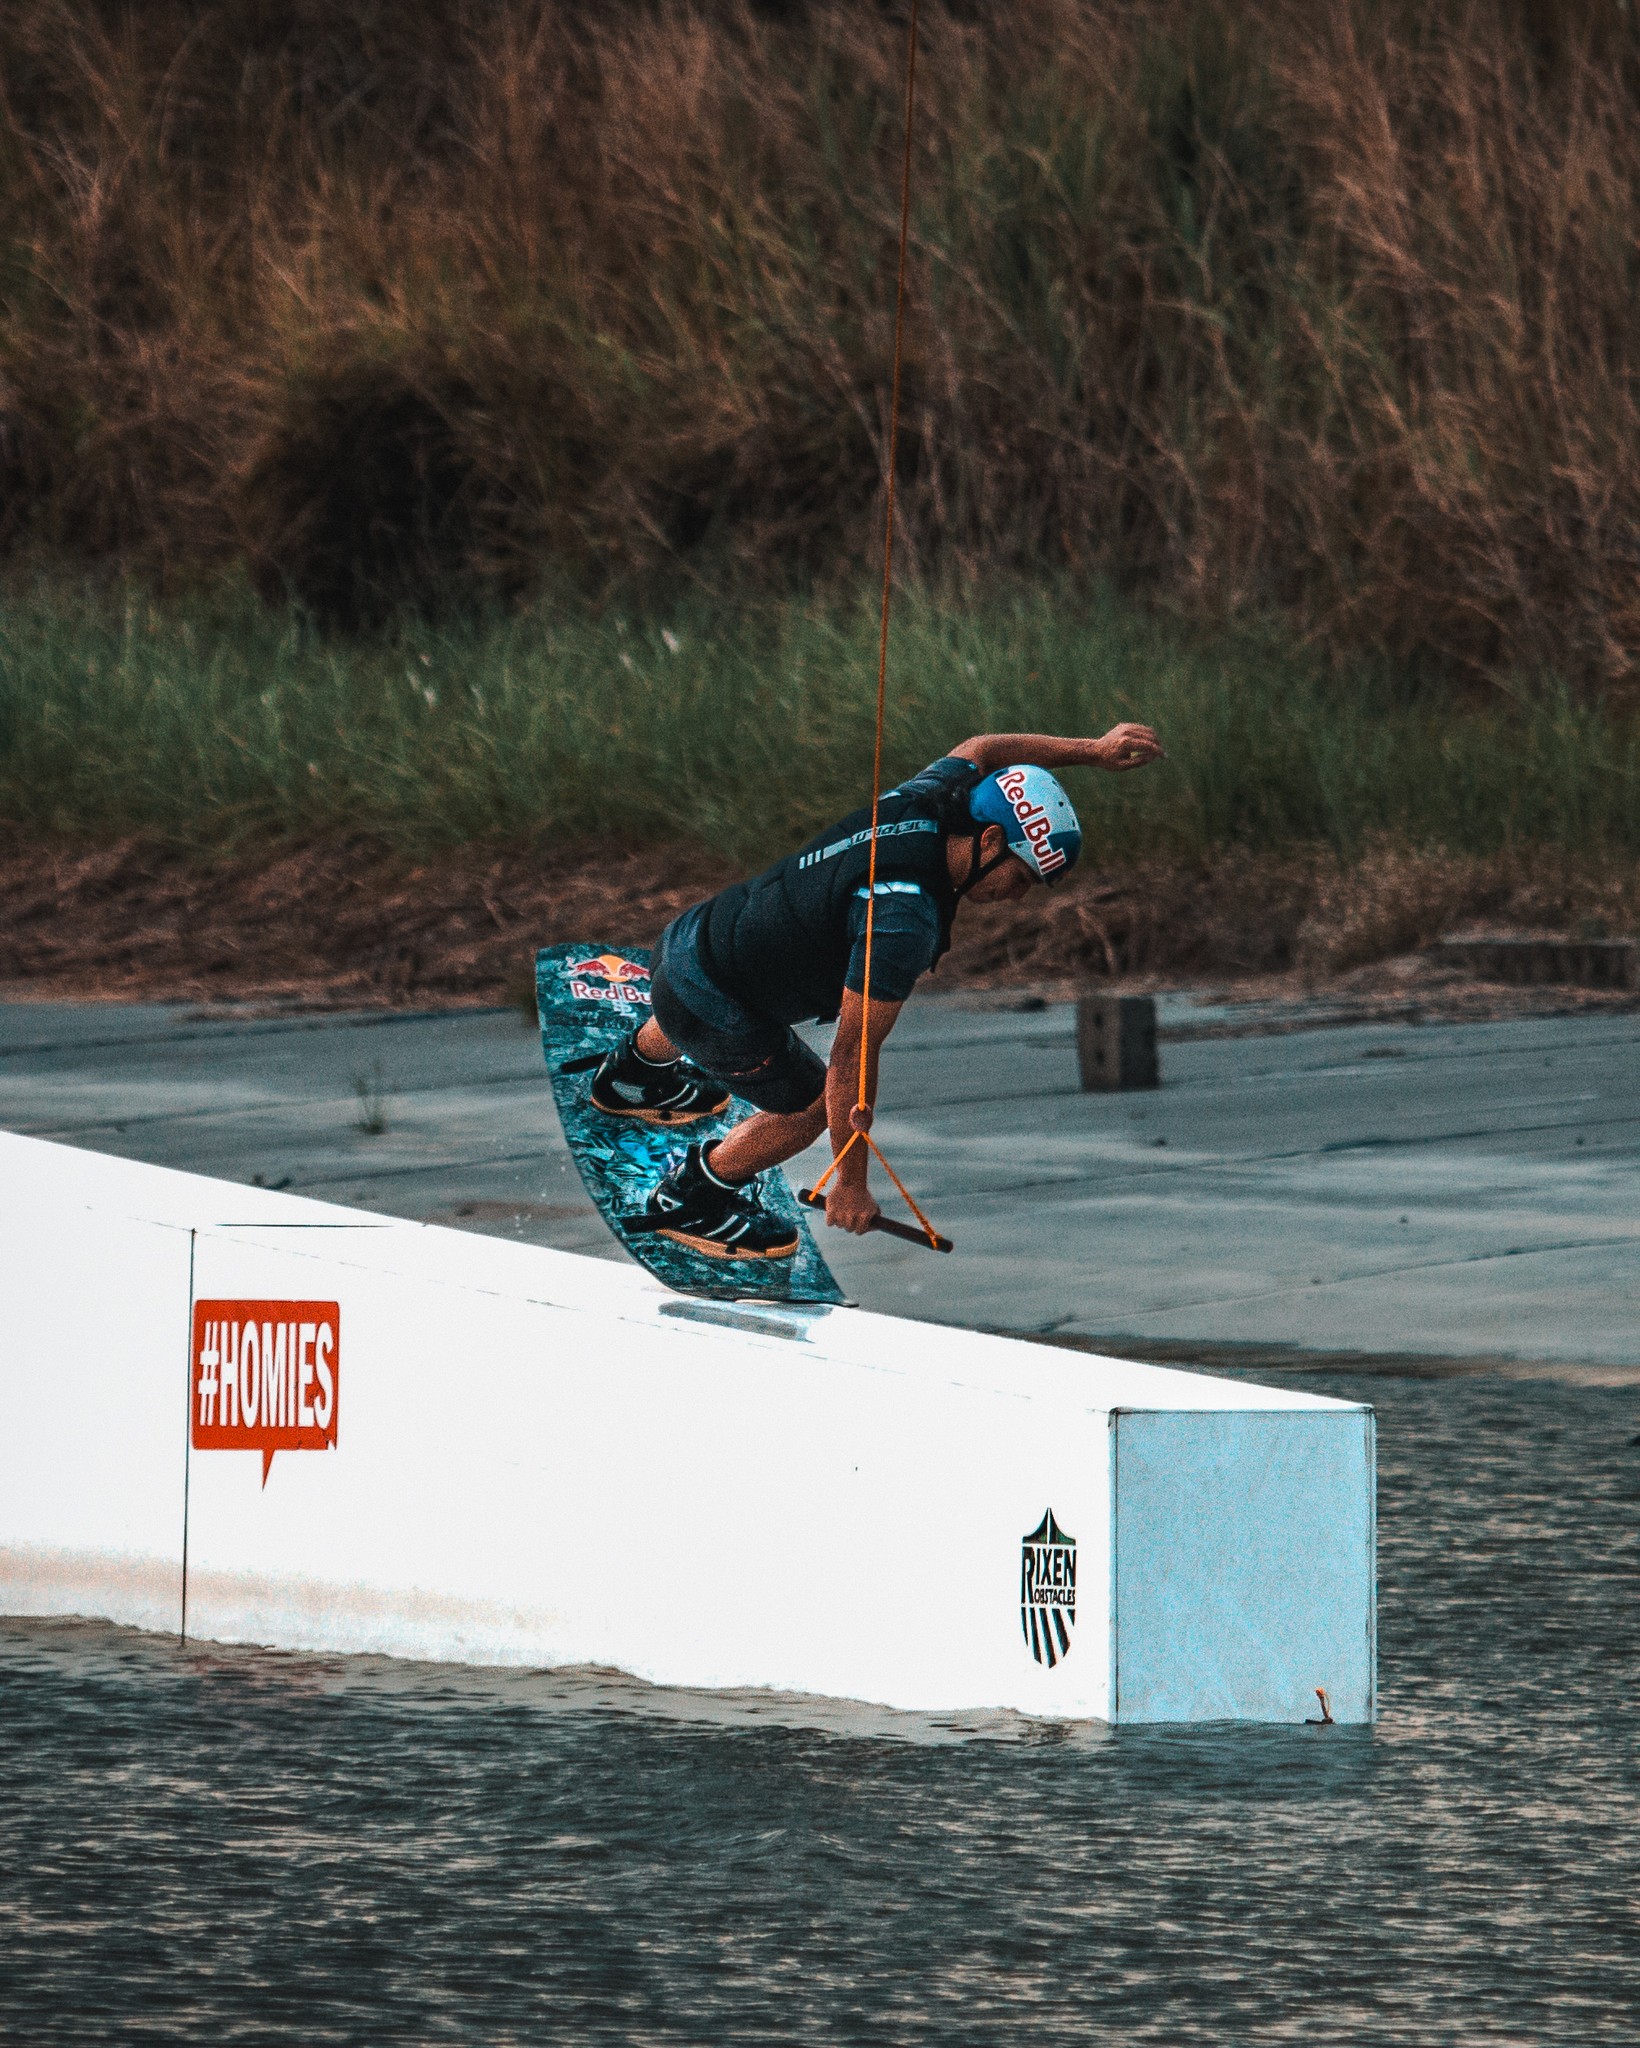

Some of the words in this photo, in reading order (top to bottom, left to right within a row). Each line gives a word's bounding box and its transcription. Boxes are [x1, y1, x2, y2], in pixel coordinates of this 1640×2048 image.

[998, 770, 1045, 821] Red
[1023, 816, 1067, 873] Bull
[571, 981, 620, 1001] Red
[622, 985, 652, 1004] Bu
[198, 1320, 334, 1430] #HOMIES
[1021, 1546, 1077, 1604] RIXEN
[1033, 1588, 1076, 1605] OBSTACLES
